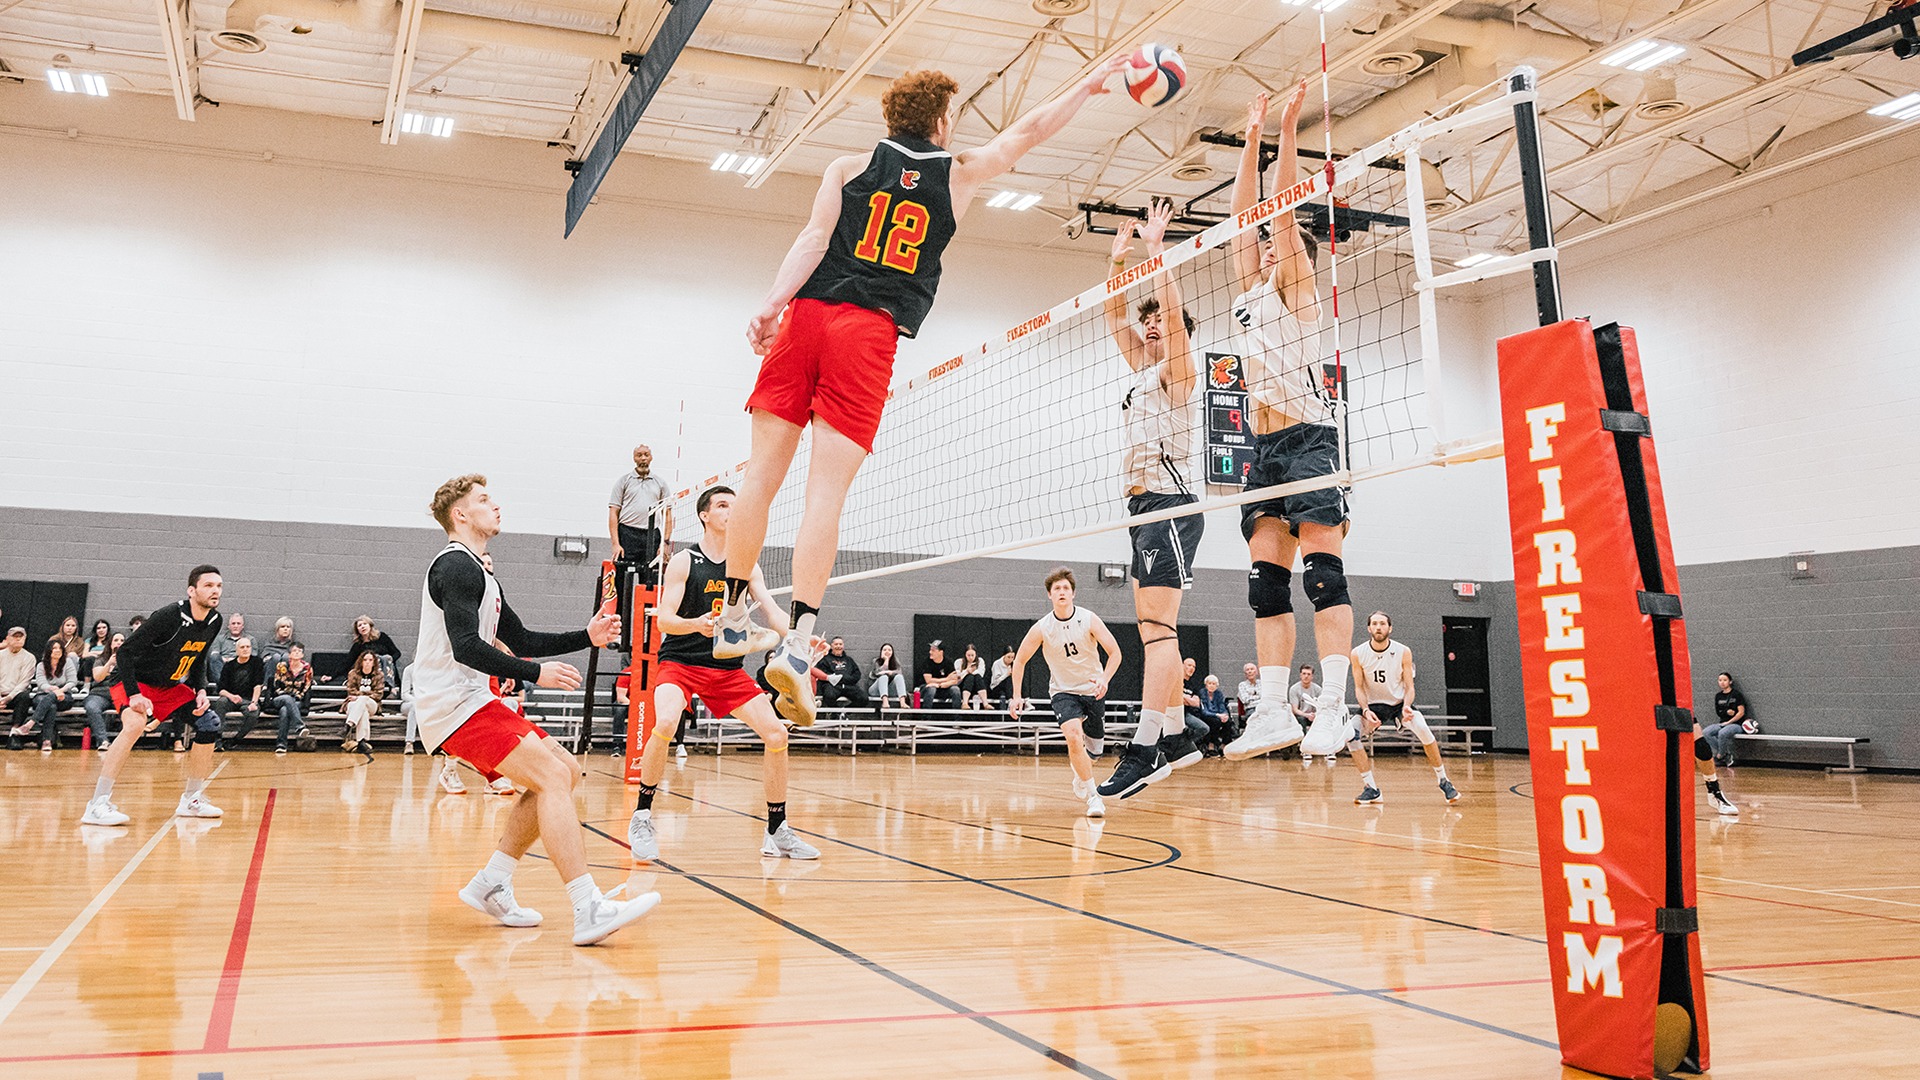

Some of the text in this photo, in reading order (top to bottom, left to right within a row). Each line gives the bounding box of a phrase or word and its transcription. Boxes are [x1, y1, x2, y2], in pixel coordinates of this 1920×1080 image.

[1237, 177, 1316, 229] FIRESTORM
[854, 191, 931, 275] 12
[1106, 254, 1164, 294] FIRESTORM
[1006, 311, 1051, 343] FIRESTORM
[928, 354, 964, 381] FIRESTORM
[1212, 394, 1240, 407] HOME
[1228, 409, 1241, 431] 9
[1223, 433, 1246, 444] BONUS
[1211, 446, 1234, 457] FOULS
[1222, 456, 1233, 474] 0
[704, 579, 725, 594] AC
[1063, 641, 1079, 658] 13
[1373, 669, 1387, 684] 15
[1525, 401, 1624, 999] FIRESTORM
